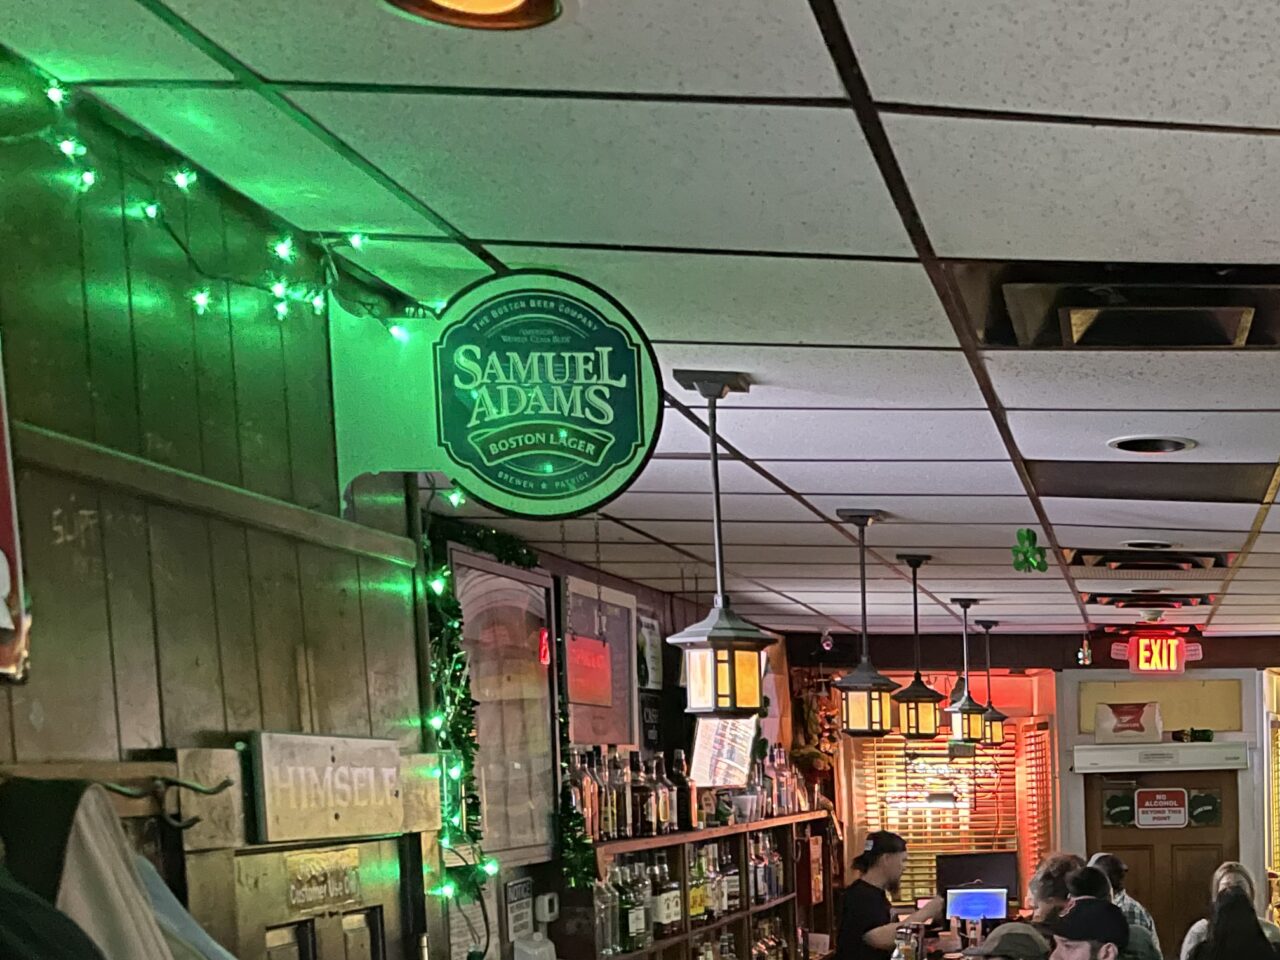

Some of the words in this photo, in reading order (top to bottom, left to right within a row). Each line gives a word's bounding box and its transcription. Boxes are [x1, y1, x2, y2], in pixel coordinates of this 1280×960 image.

[472, 315, 491, 332] THE
[492, 299, 526, 319] BOSTON
[530, 299, 555, 309] BEER
[558, 303, 599, 331] COMPANY
[453, 344, 627, 390] SAMUEL
[467, 385, 614, 427] ADAMS
[489, 432, 546, 456] BOSTON
[550, 433, 596, 456] LAGER
[497, 471, 535, 489] BREWER
[554, 471, 590, 489] PATRIOT
[1138, 638, 1180, 672] EXIT
[271, 766, 398, 810] HIMSELF
[1155, 793, 1167, 801] NO
[507, 882, 531, 901] NOTICE
